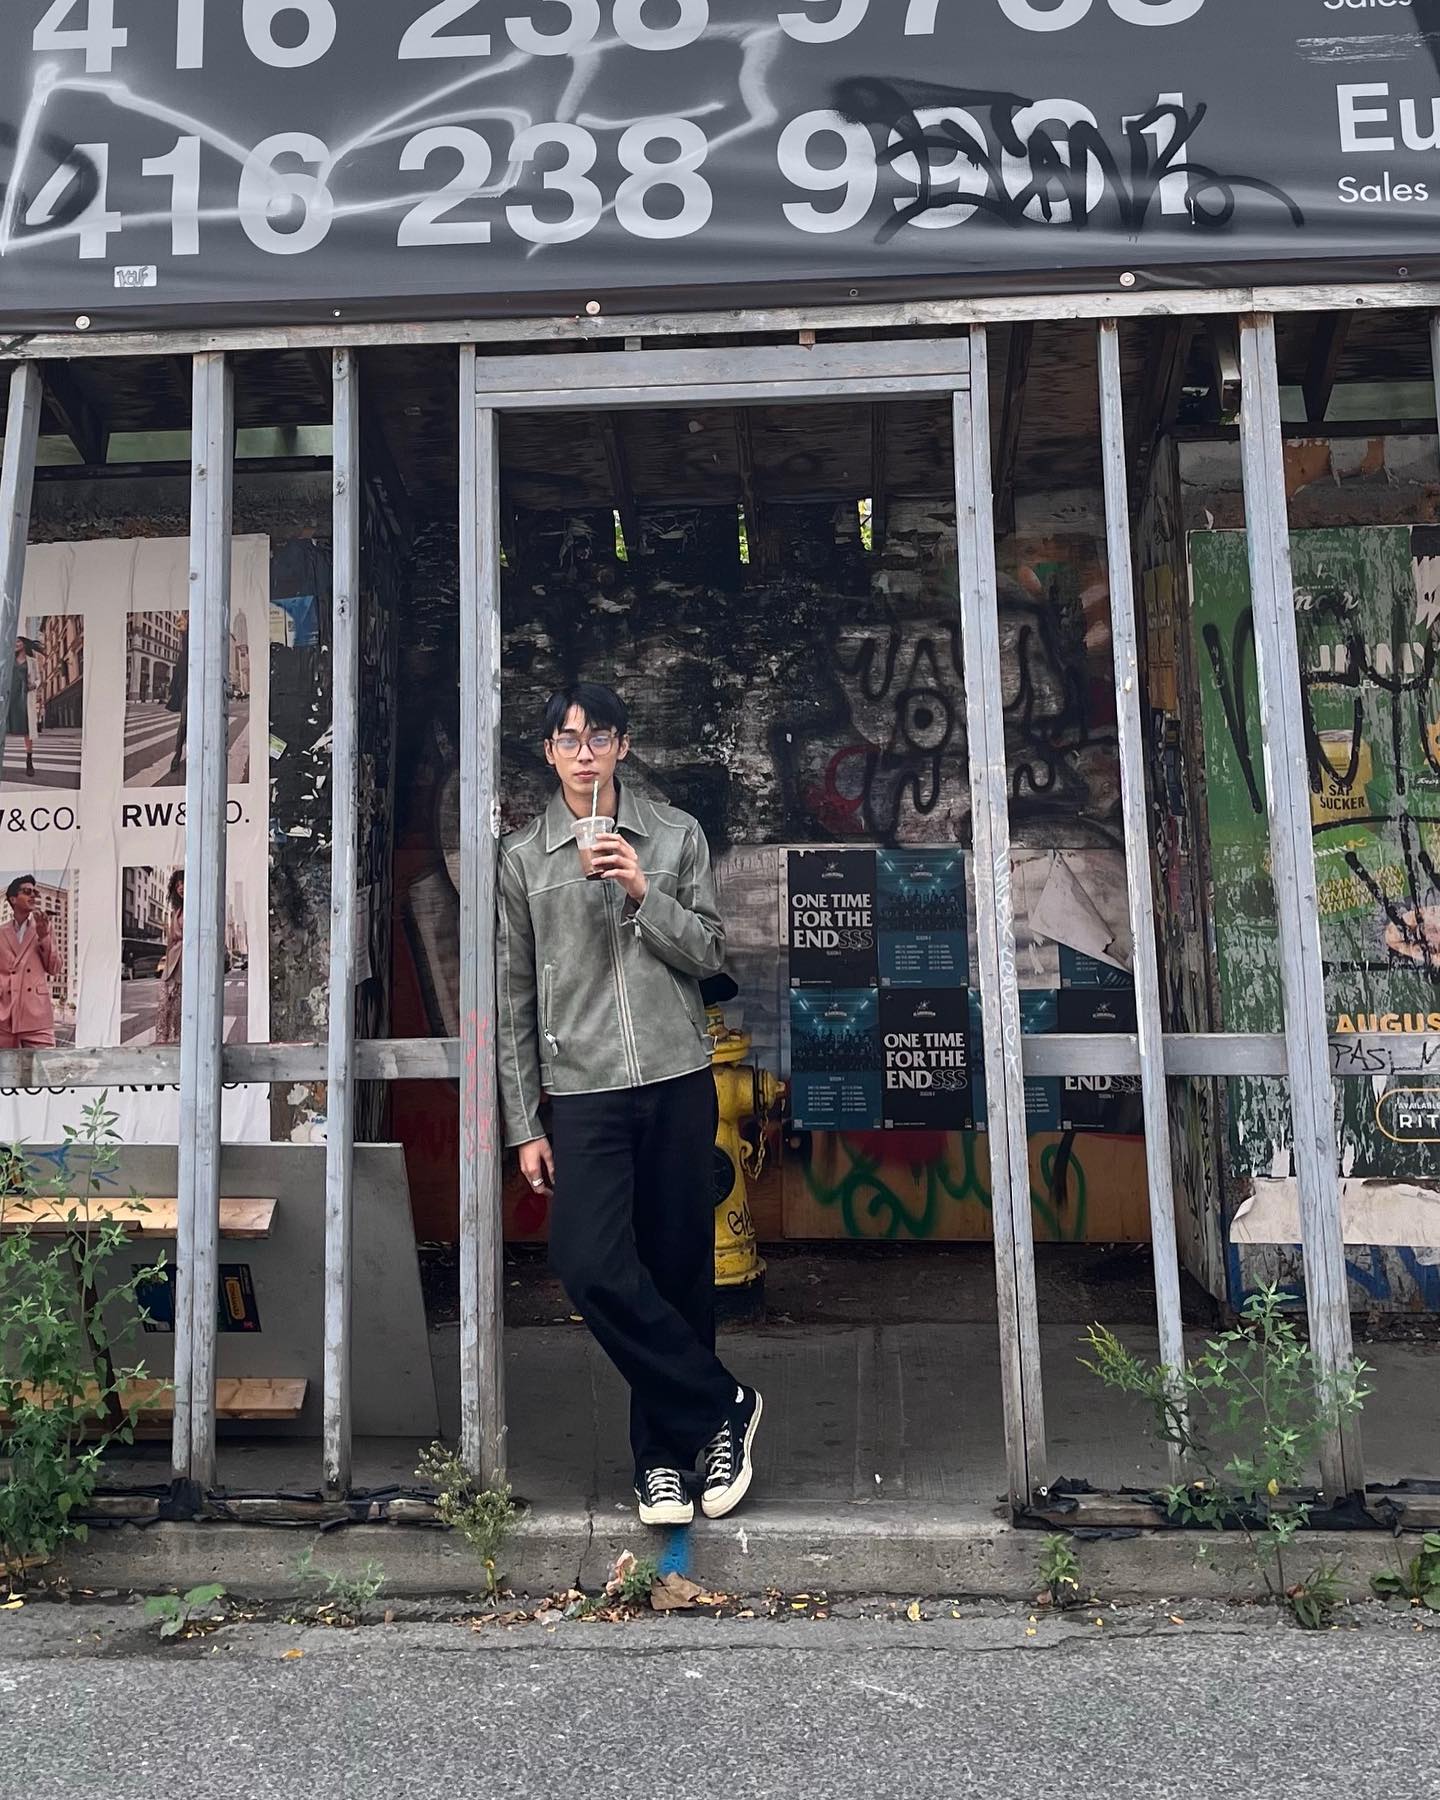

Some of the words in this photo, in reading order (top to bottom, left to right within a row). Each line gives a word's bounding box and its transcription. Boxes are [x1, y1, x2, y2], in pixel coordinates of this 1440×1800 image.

[1336, 82, 1440, 152] Eu
[26, 132, 334, 259] 416
[397, 117, 713, 247] 238
[1338, 171, 1429, 202] Sales
[1328, 784, 1353, 797] SAP
[1320, 796, 1365, 810] SUCKER
[0, 806, 81, 832] &CO.
[122, 800, 250, 828] RW&O.
[792, 893, 829, 908] ONE
[830, 893, 872, 908] TIME
[793, 910, 834, 927] FOR
[834, 910, 873, 927] THE
[793, 929, 874, 949] ENDSSS
[1336, 1012, 1440, 1033] AUGUS
[884, 1033, 921, 1048] ONE
[923, 1032, 965, 1048] TIME
[886, 1051, 927, 1067] FOR
[927, 1050, 967, 1067] THE
[886, 1069, 968, 1090] ENDSSS
[1400, 1113, 1439, 1129] RIT
